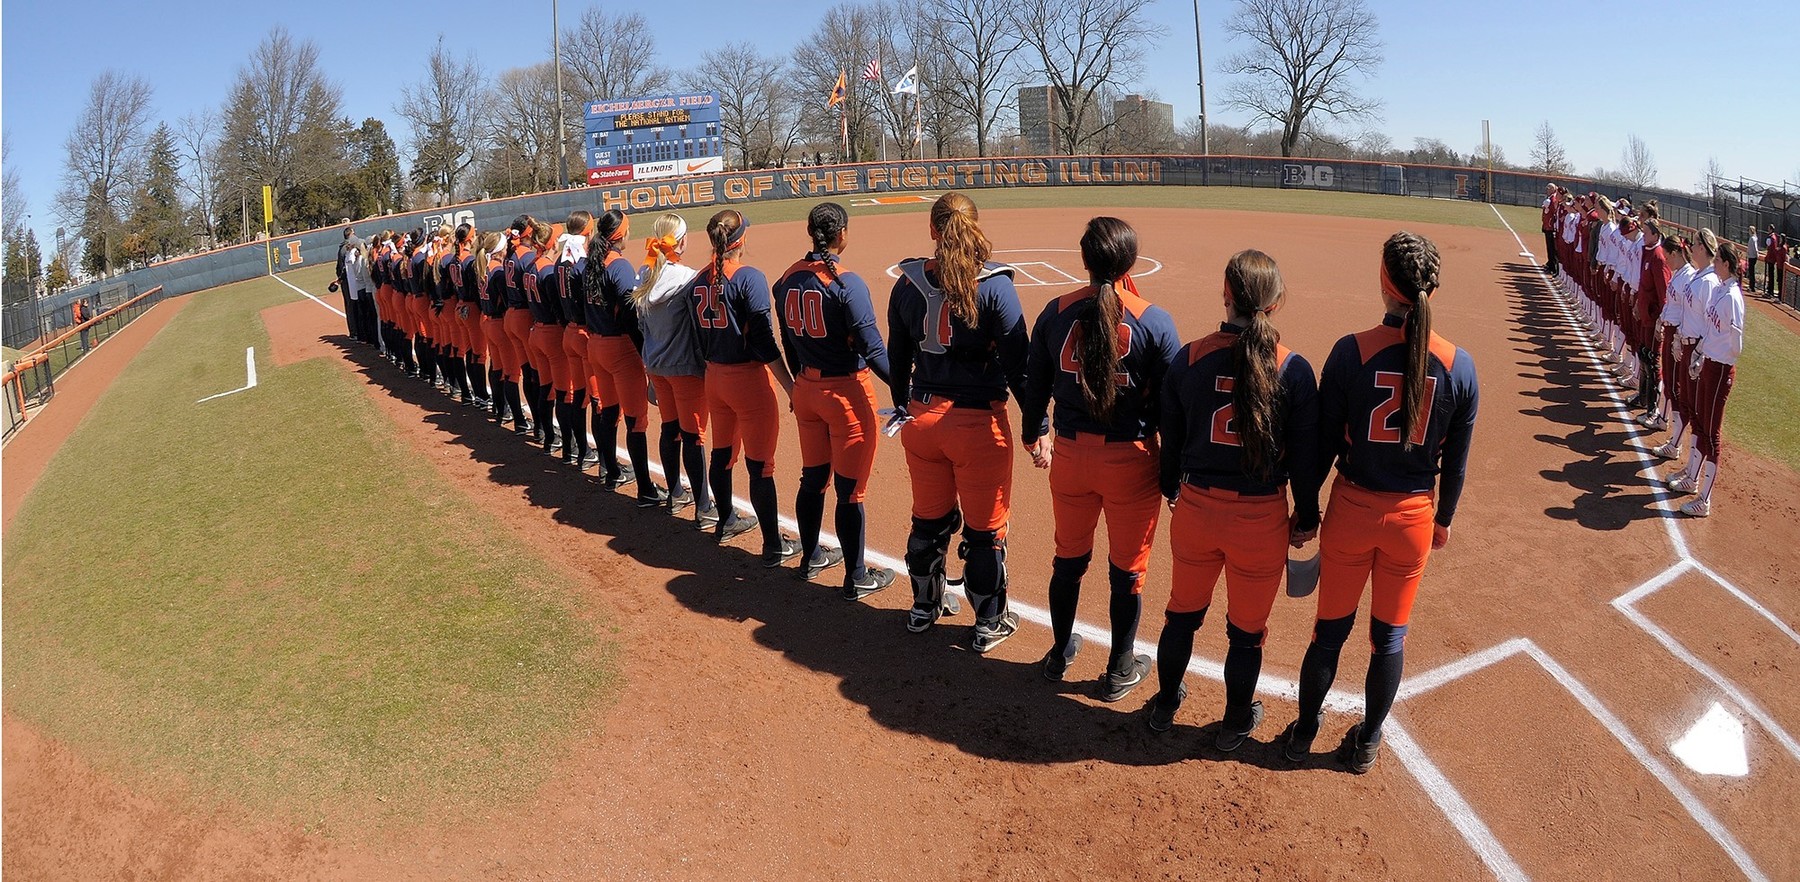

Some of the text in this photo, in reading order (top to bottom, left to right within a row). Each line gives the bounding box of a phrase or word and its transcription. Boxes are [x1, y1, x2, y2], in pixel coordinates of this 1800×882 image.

[591, 95, 713, 114] EICHELBERGER FIELD
[620, 108, 685, 121] PLEASE STAND FOR
[615, 120, 628, 128] THE
[630, 117, 662, 127] NATIONAL
[594, 151, 611, 159] GUEST
[637, 164, 674, 174] ILLINOIS
[602, 161, 1161, 211] HOME OF THE FIGHTING ILLINI
[287, 240, 303, 265] I
[523, 272, 542, 303] 99
[693, 285, 729, 329] 25
[784, 288, 827, 339] 40
[1367, 371, 1438, 447] 21
